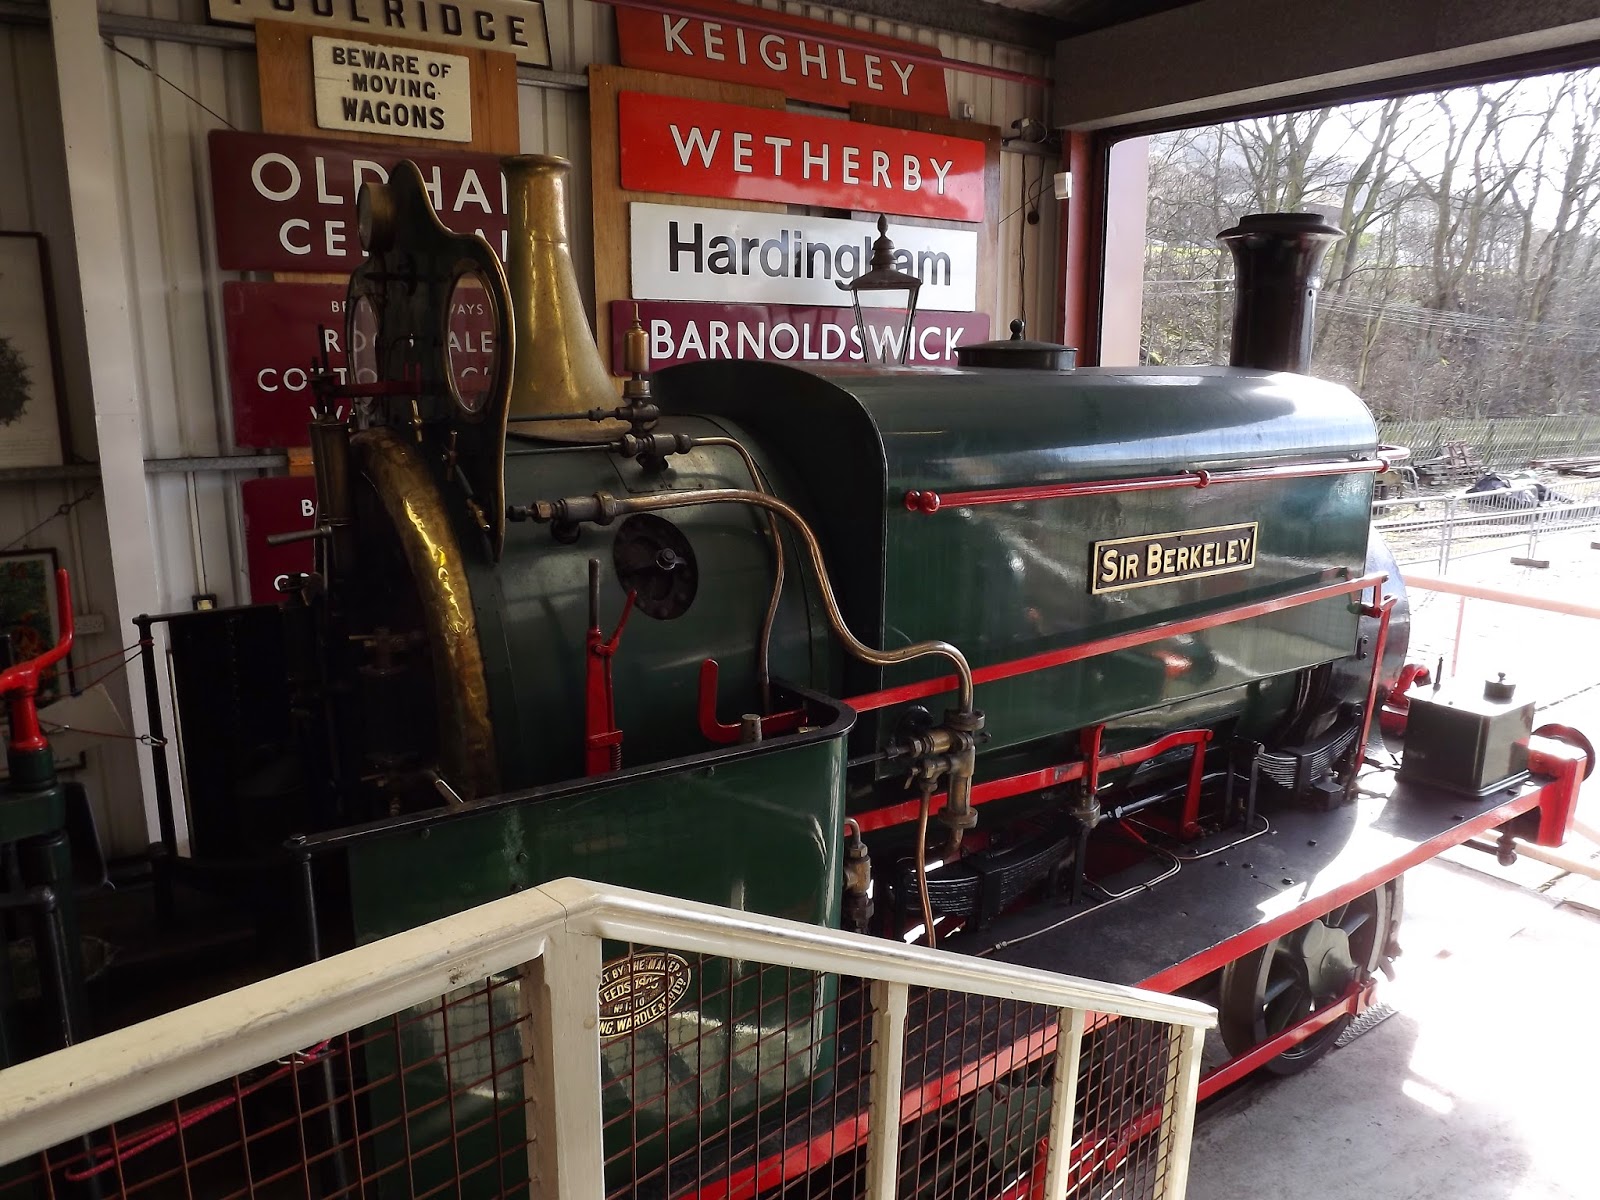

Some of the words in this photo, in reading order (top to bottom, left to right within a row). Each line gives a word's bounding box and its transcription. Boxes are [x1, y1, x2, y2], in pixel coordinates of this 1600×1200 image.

[233, 0, 529, 47] ULRIDGE
[332, 46, 419, 75] BEWARE
[428, 62, 452, 79] OF
[663, 14, 915, 96] KEIGHLEY
[352, 73, 437, 101] MOVING
[342, 97, 445, 131] WAGONS
[669, 124, 953, 195] WETHERBY
[251, 152, 508, 215] OLDHA
[651, 318, 965, 361] BARNOLDSWICK
[1101, 549, 1139, 583] SIR
[1146, 538, 1250, 577] BERKELEY
[612, 966, 625, 979] BY
[617, 1003, 659, 1032] WARDLE
